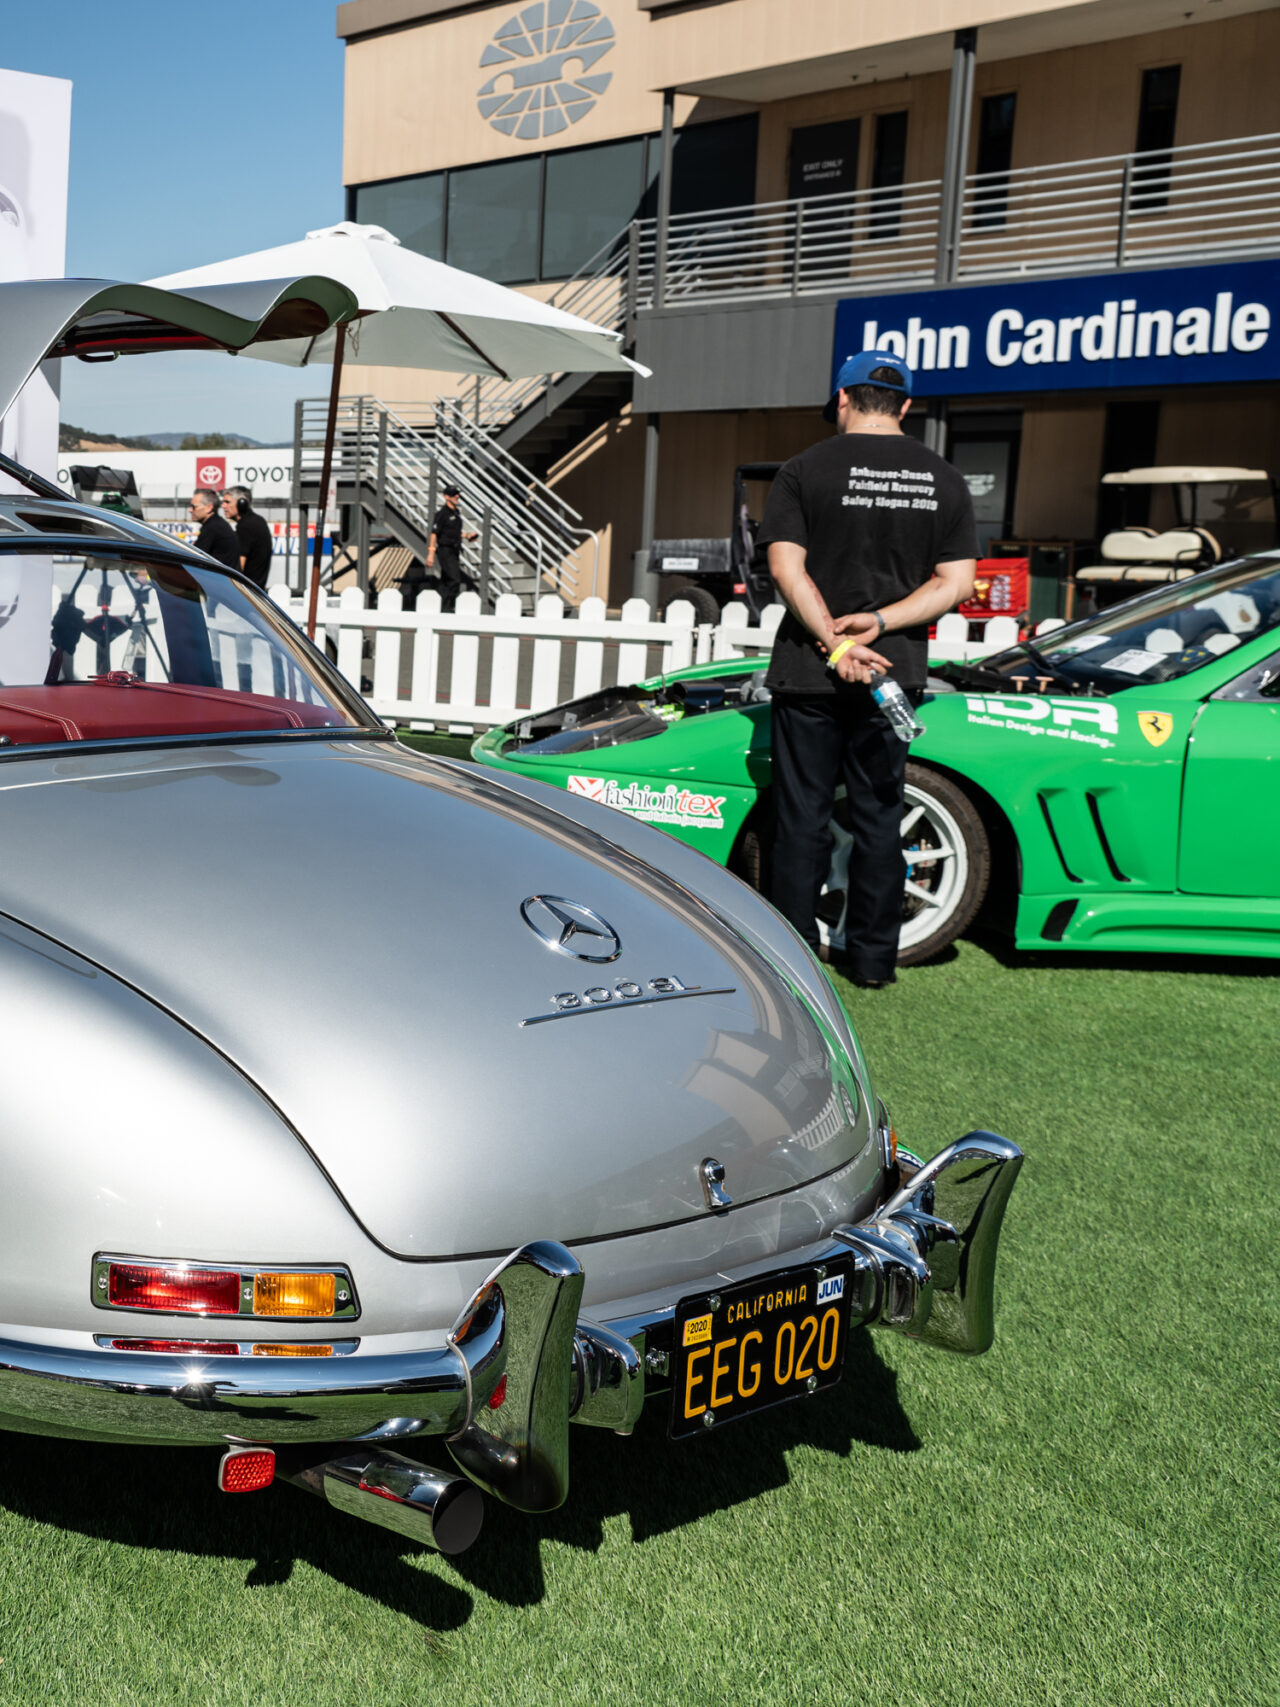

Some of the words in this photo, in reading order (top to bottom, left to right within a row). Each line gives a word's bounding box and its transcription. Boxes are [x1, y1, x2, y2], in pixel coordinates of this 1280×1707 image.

[821, 159, 843, 169] ONLY
[846, 317, 970, 371] John
[986, 292, 1270, 367] Cardinale
[234, 467, 293, 482] TOYOT
[850, 467, 934, 482] Anheuser-Busch
[848, 480, 889, 491] Fairfield
[891, 482, 935, 496] Brewery
[841, 495, 873, 508] Safety
[875, 497, 910, 509] Slogan
[912, 499, 938, 511] 2019
[967, 713, 1005, 728] Italian
[1006, 719, 1045, 735] Design
[1046, 728, 1069, 739] and
[727, 1285, 807, 1324] CALIFORNIA
[819, 1278, 843, 1299] JUN
[690, 1319, 707, 1334] 2020
[684, 1330, 763, 1419] EEG
[774, 1307, 840, 1385] 020
